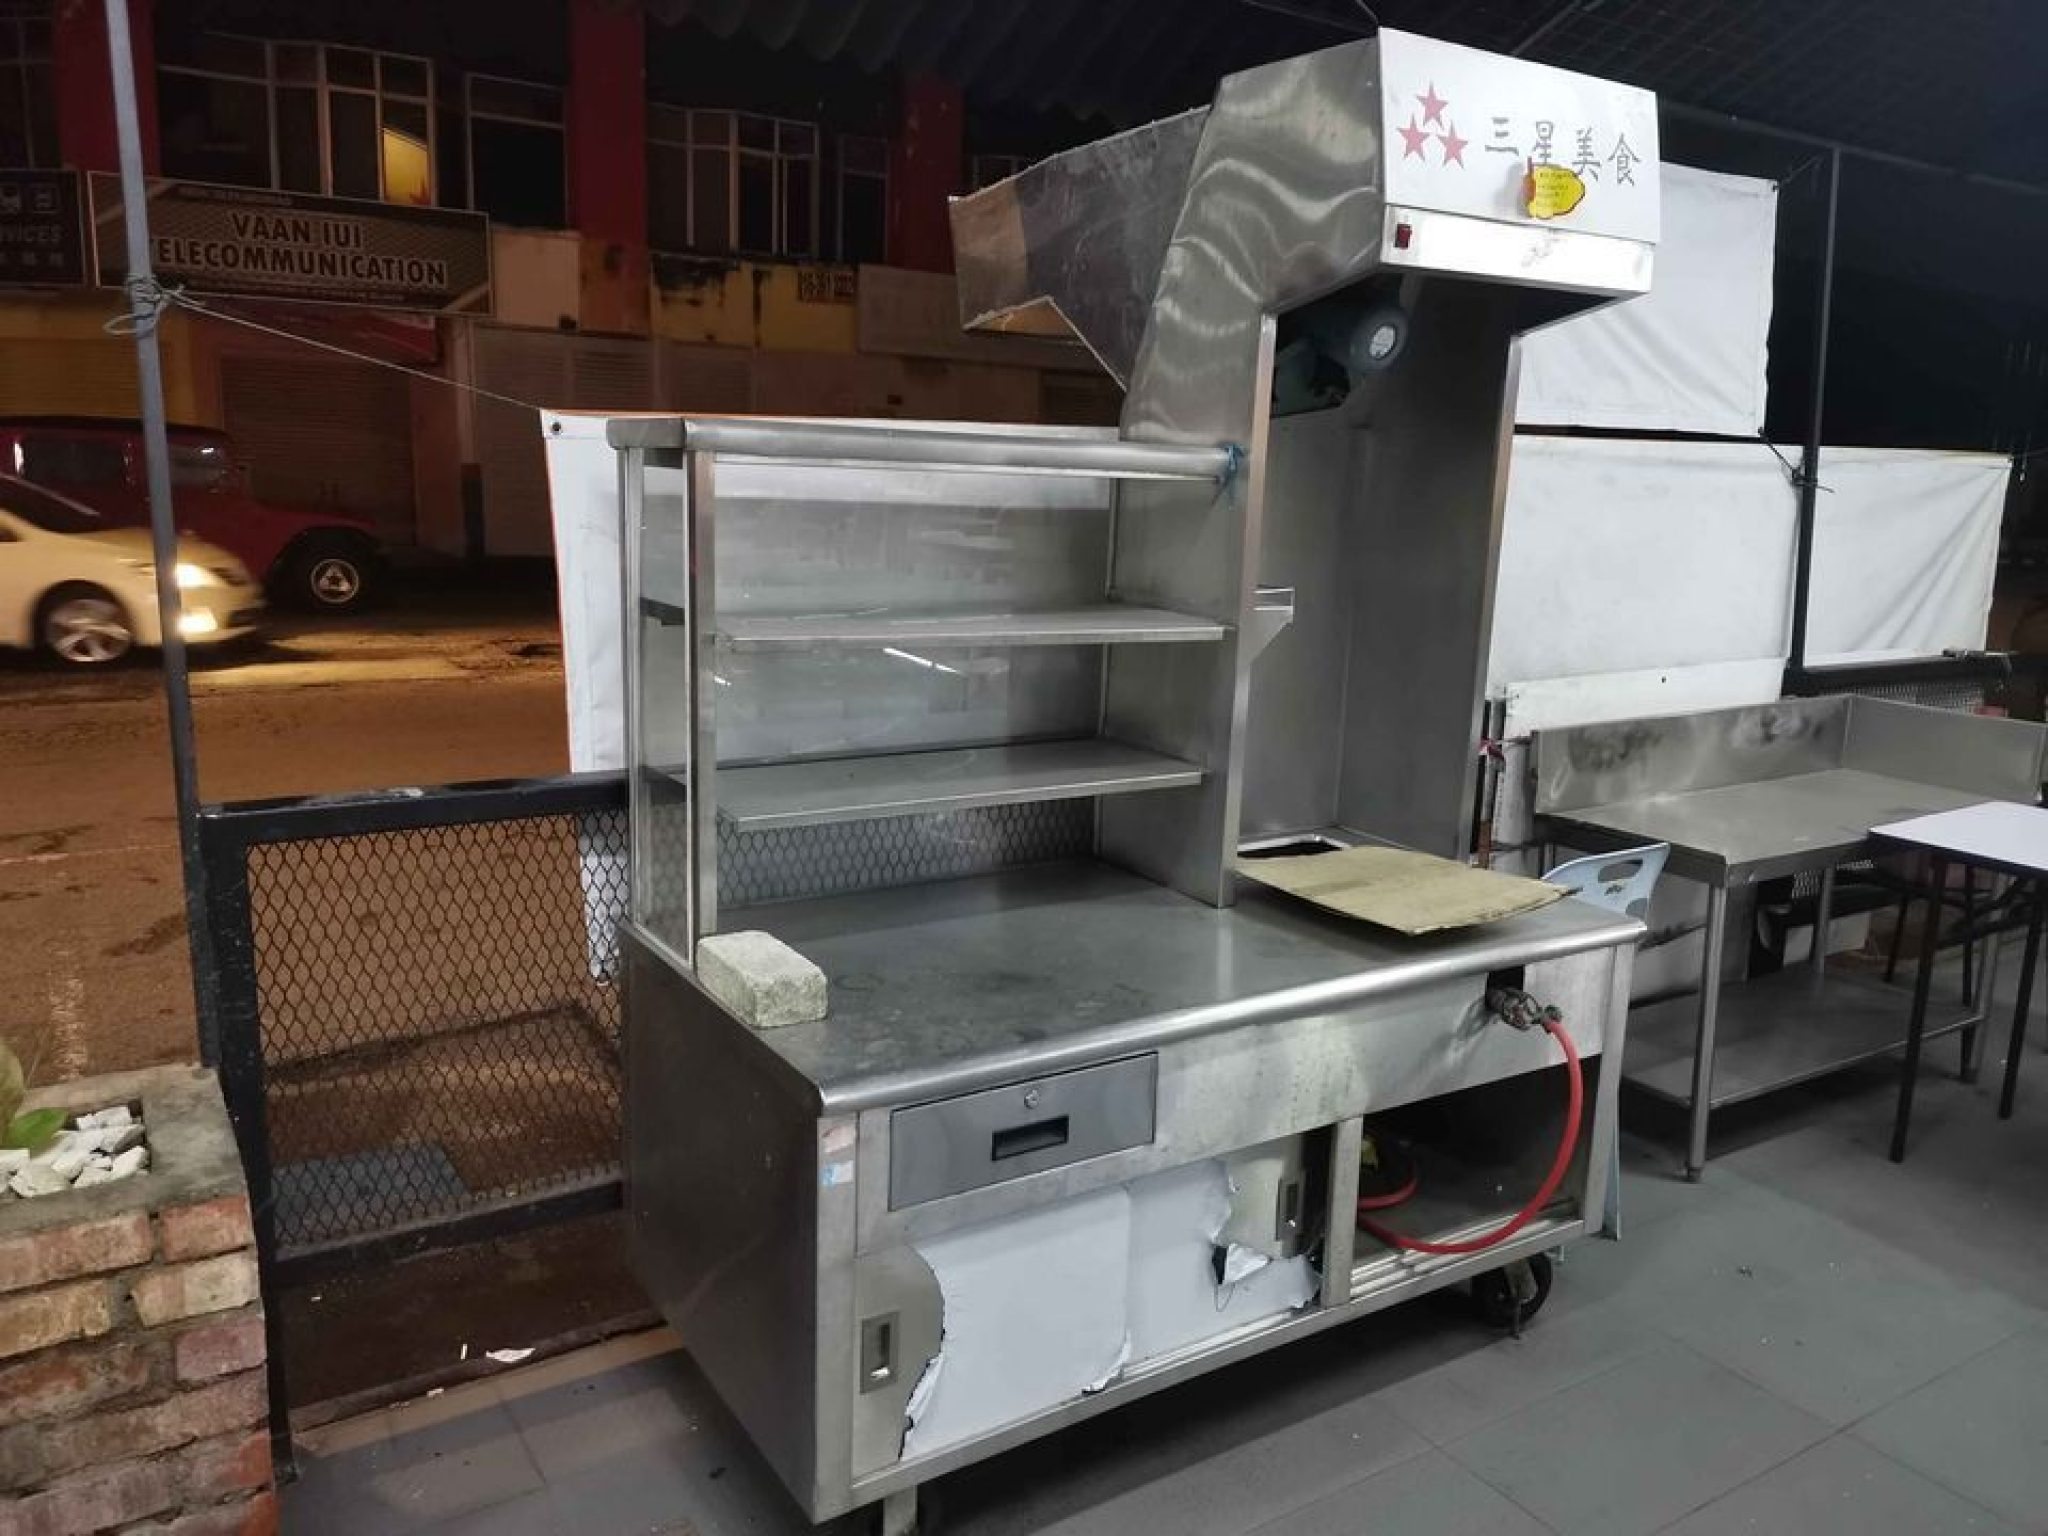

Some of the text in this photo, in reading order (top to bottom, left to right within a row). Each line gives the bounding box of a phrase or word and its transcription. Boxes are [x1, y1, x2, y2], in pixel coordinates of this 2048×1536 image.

[1484, 116, 1642, 187] 三星美食
[233, 212, 311, 243] VAAN
[151, 236, 447, 286] ELECOMMUNICATION
